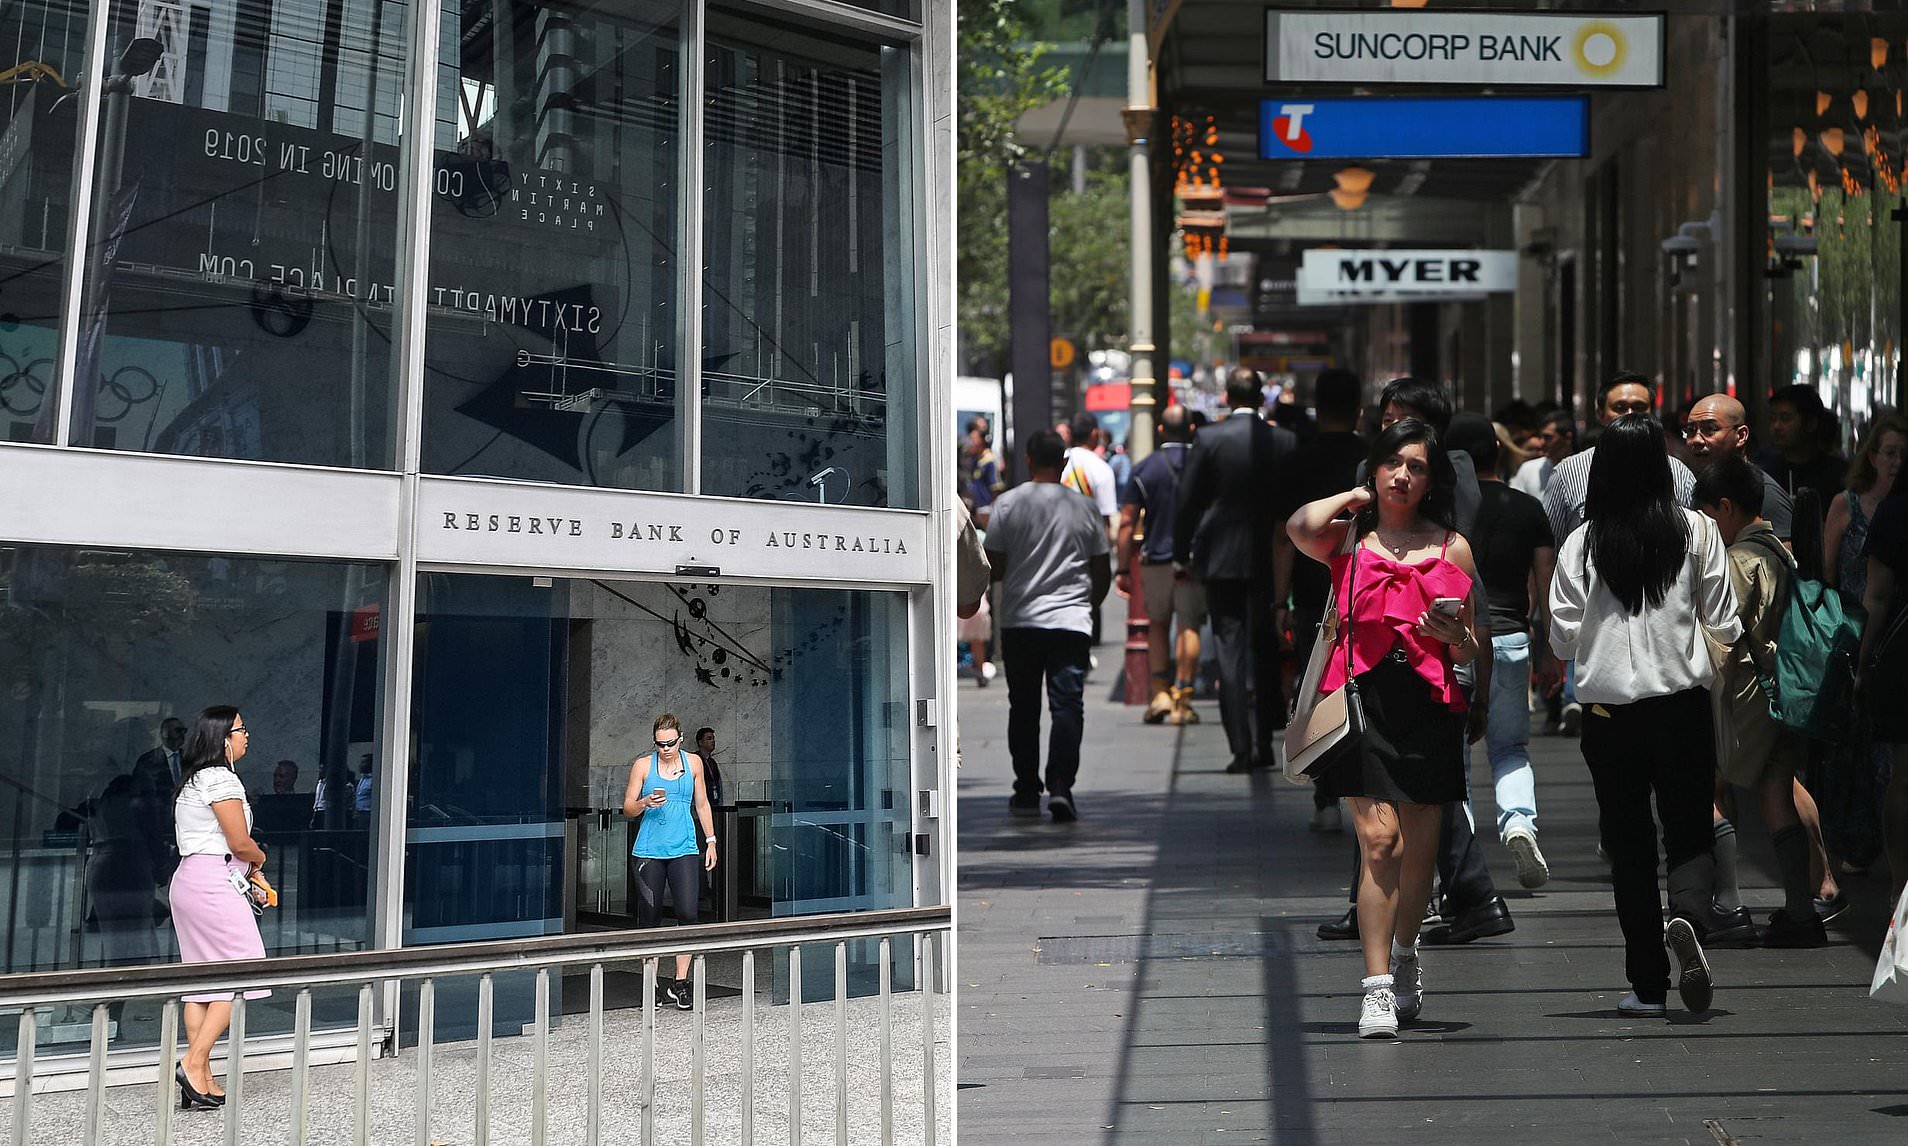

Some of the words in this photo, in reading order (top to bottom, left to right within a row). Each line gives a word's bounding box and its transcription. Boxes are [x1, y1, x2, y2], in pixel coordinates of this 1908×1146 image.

[1314, 31, 1471, 61] SUNCORP
[1479, 34, 1562, 62] BANK
[1281, 104, 1314, 140] T
[1339, 259, 1482, 283] MYER
[443, 512, 582, 537] RESERVE
[611, 521, 684, 543] BANK
[711, 529, 742, 546] OF
[766, 531, 908, 556] AUSTRALIA
